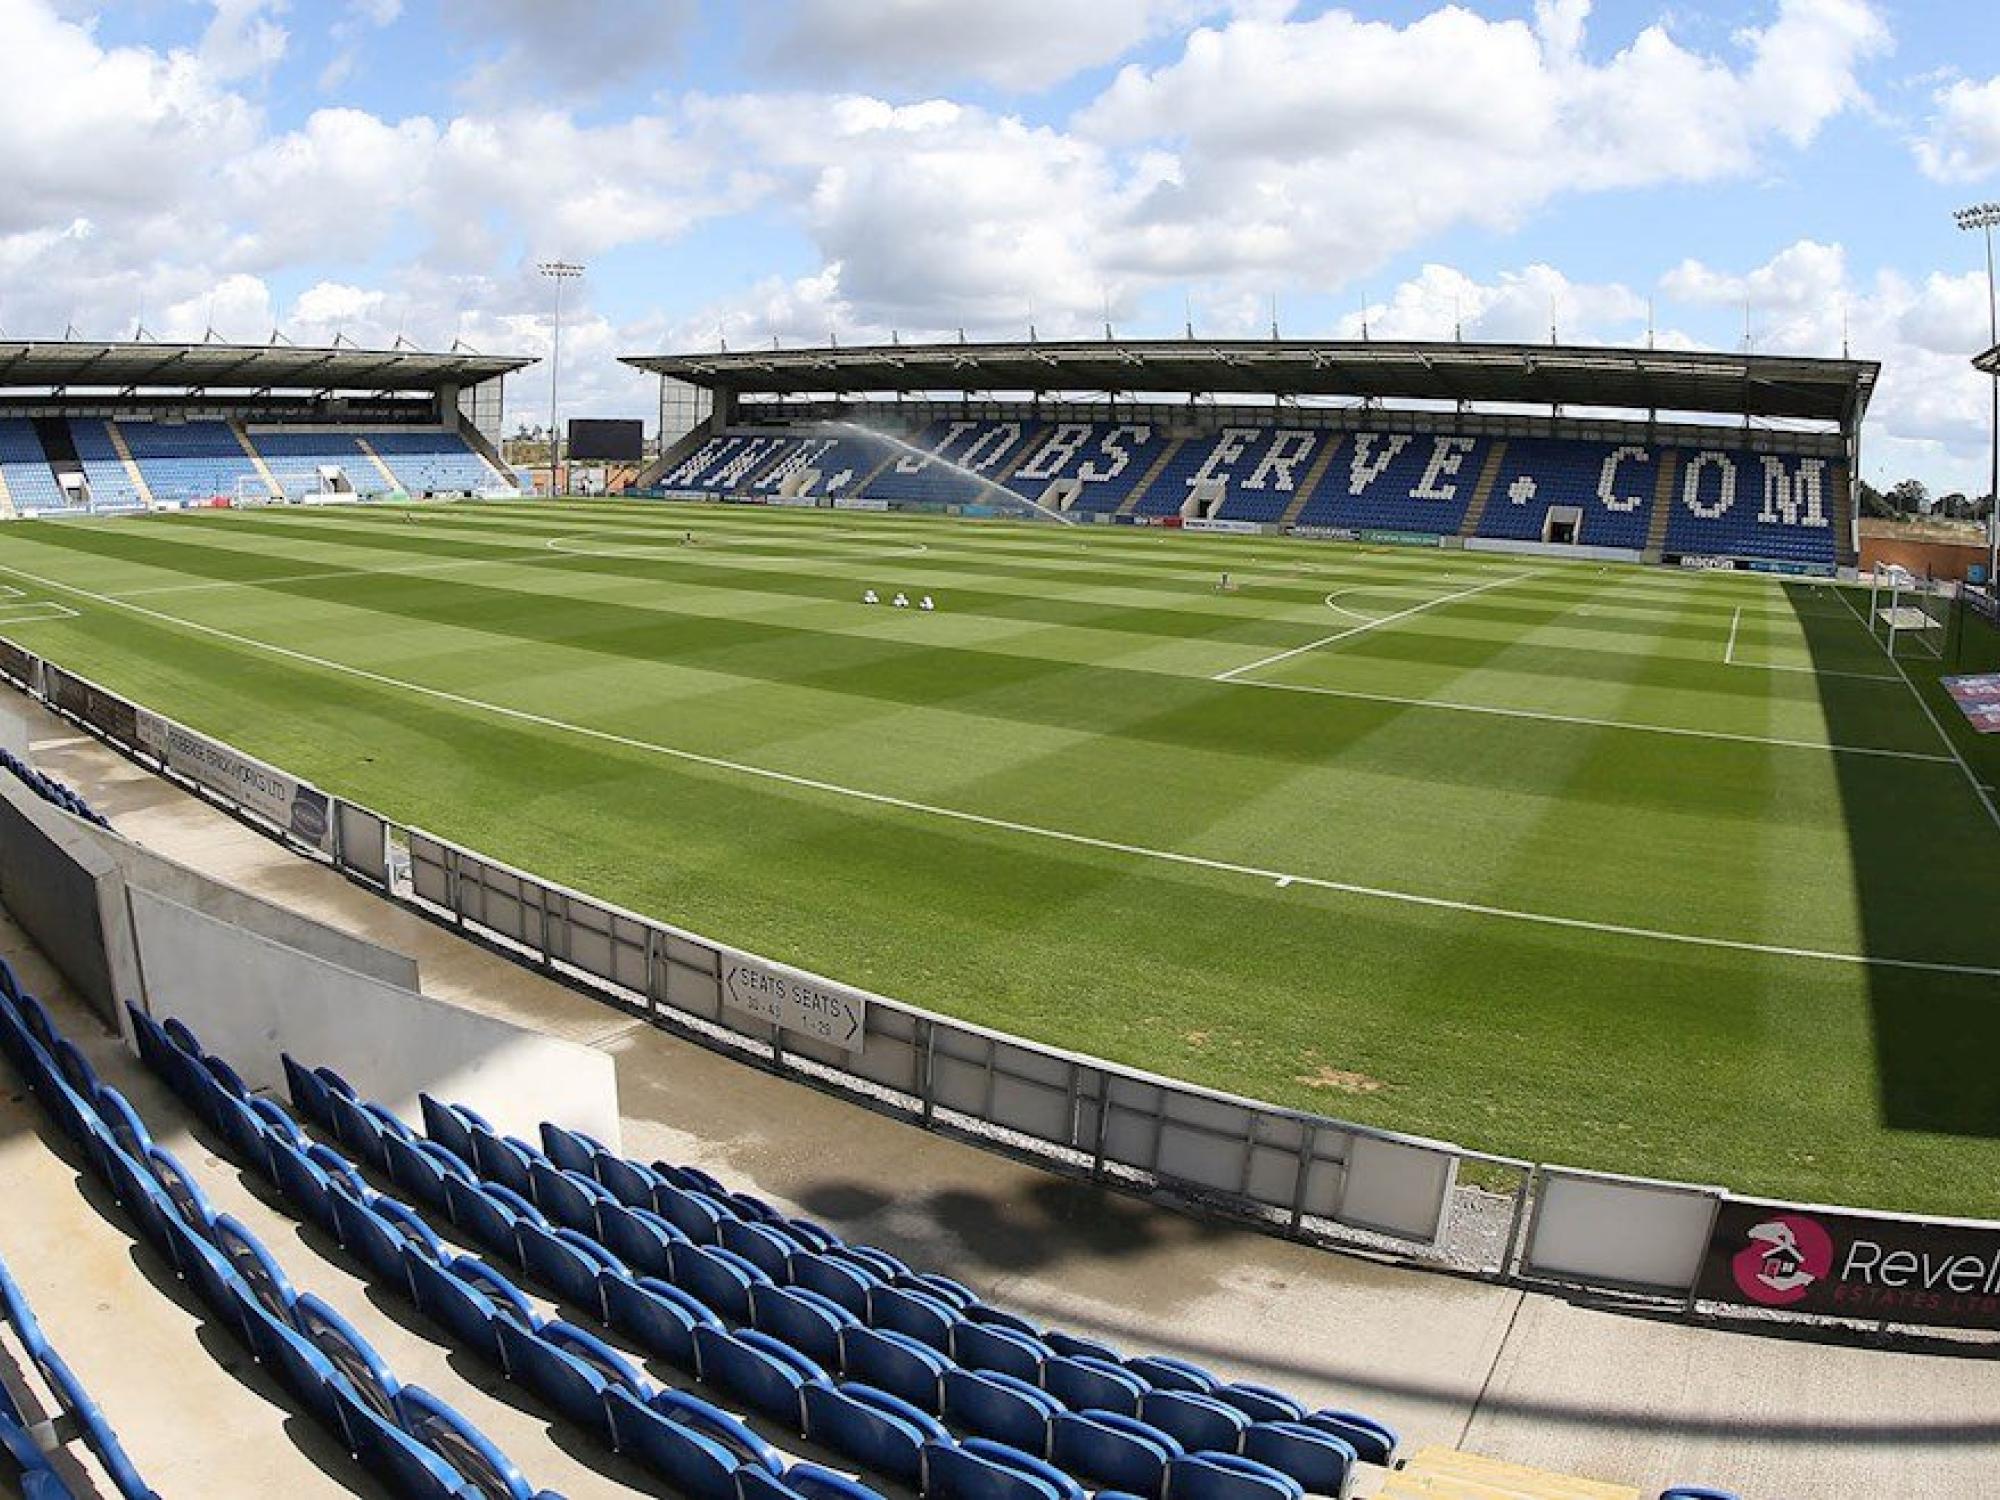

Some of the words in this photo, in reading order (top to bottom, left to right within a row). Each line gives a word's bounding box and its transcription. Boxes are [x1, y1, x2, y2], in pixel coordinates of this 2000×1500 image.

[741, 968, 786, 999] SEATS
[792, 986, 841, 1017] SEATS
[1834, 1284, 1942, 1310] ESTATES
